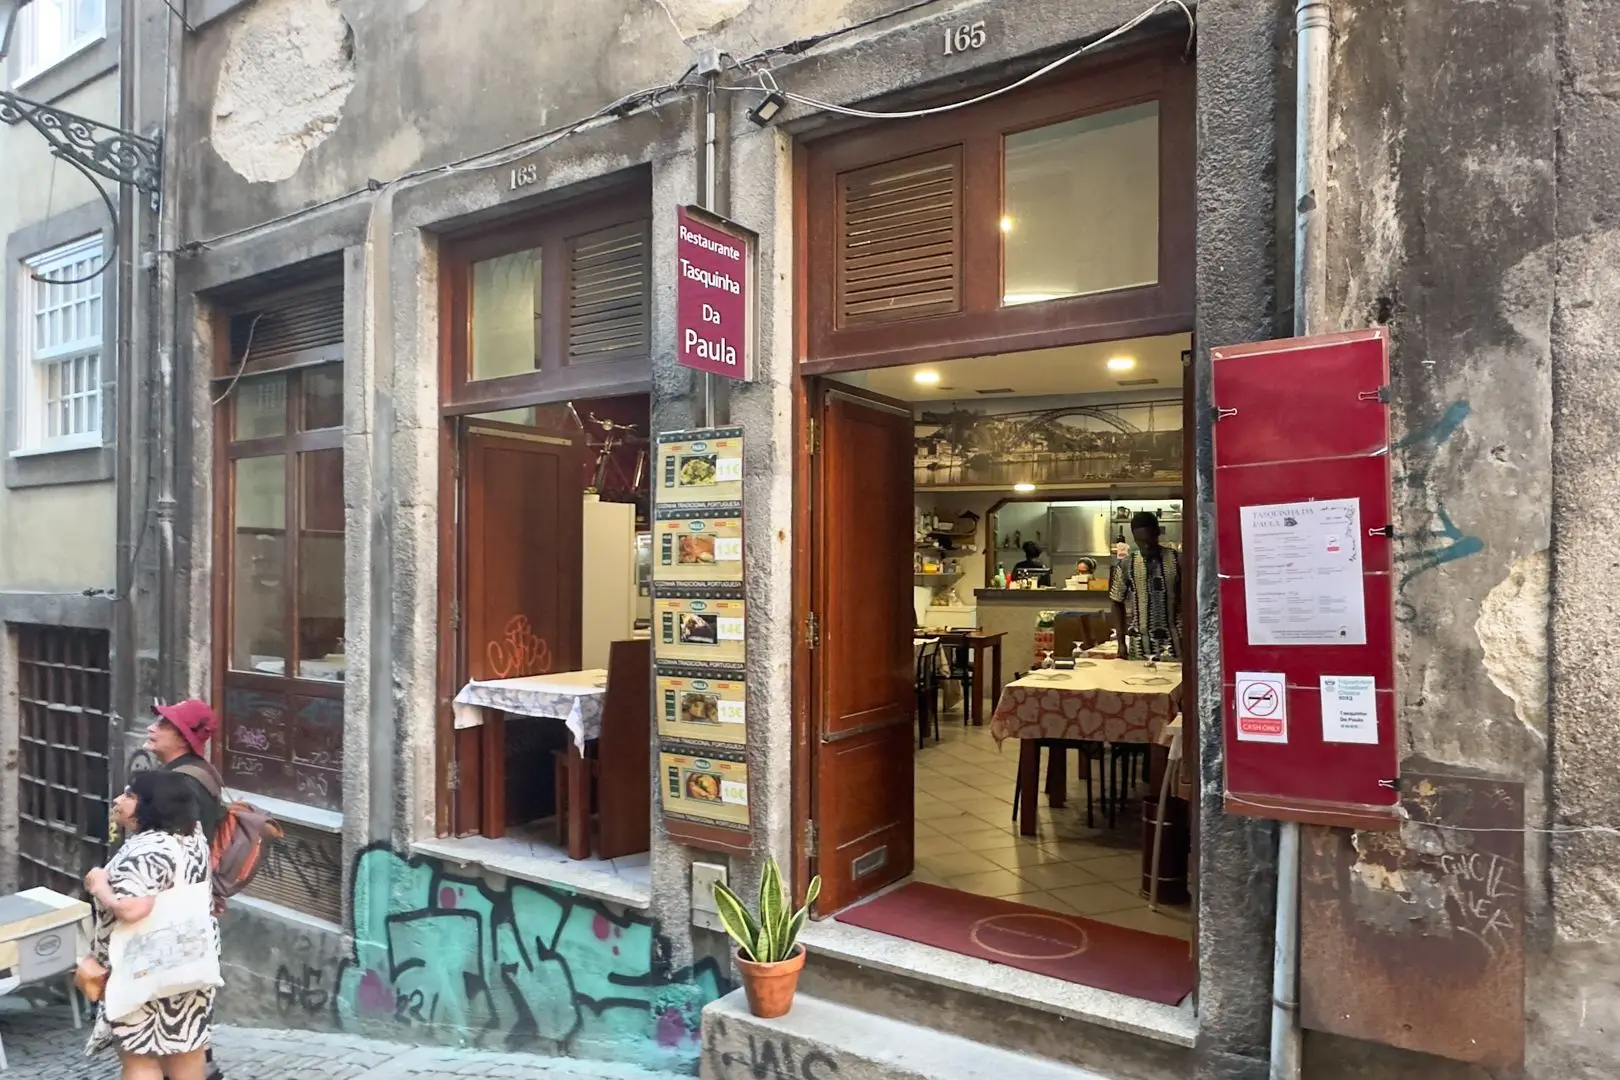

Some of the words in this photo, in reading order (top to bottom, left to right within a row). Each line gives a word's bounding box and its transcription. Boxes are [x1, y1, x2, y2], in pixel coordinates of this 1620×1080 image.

[944, 20, 986, 56] 165
[679, 225, 740, 261] Restaurante
[680, 258, 740, 295] Tasquinha
[702, 303, 721, 325] Da
[685, 328, 736, 365] Paula
[1242, 723, 1262, 731] CASH
